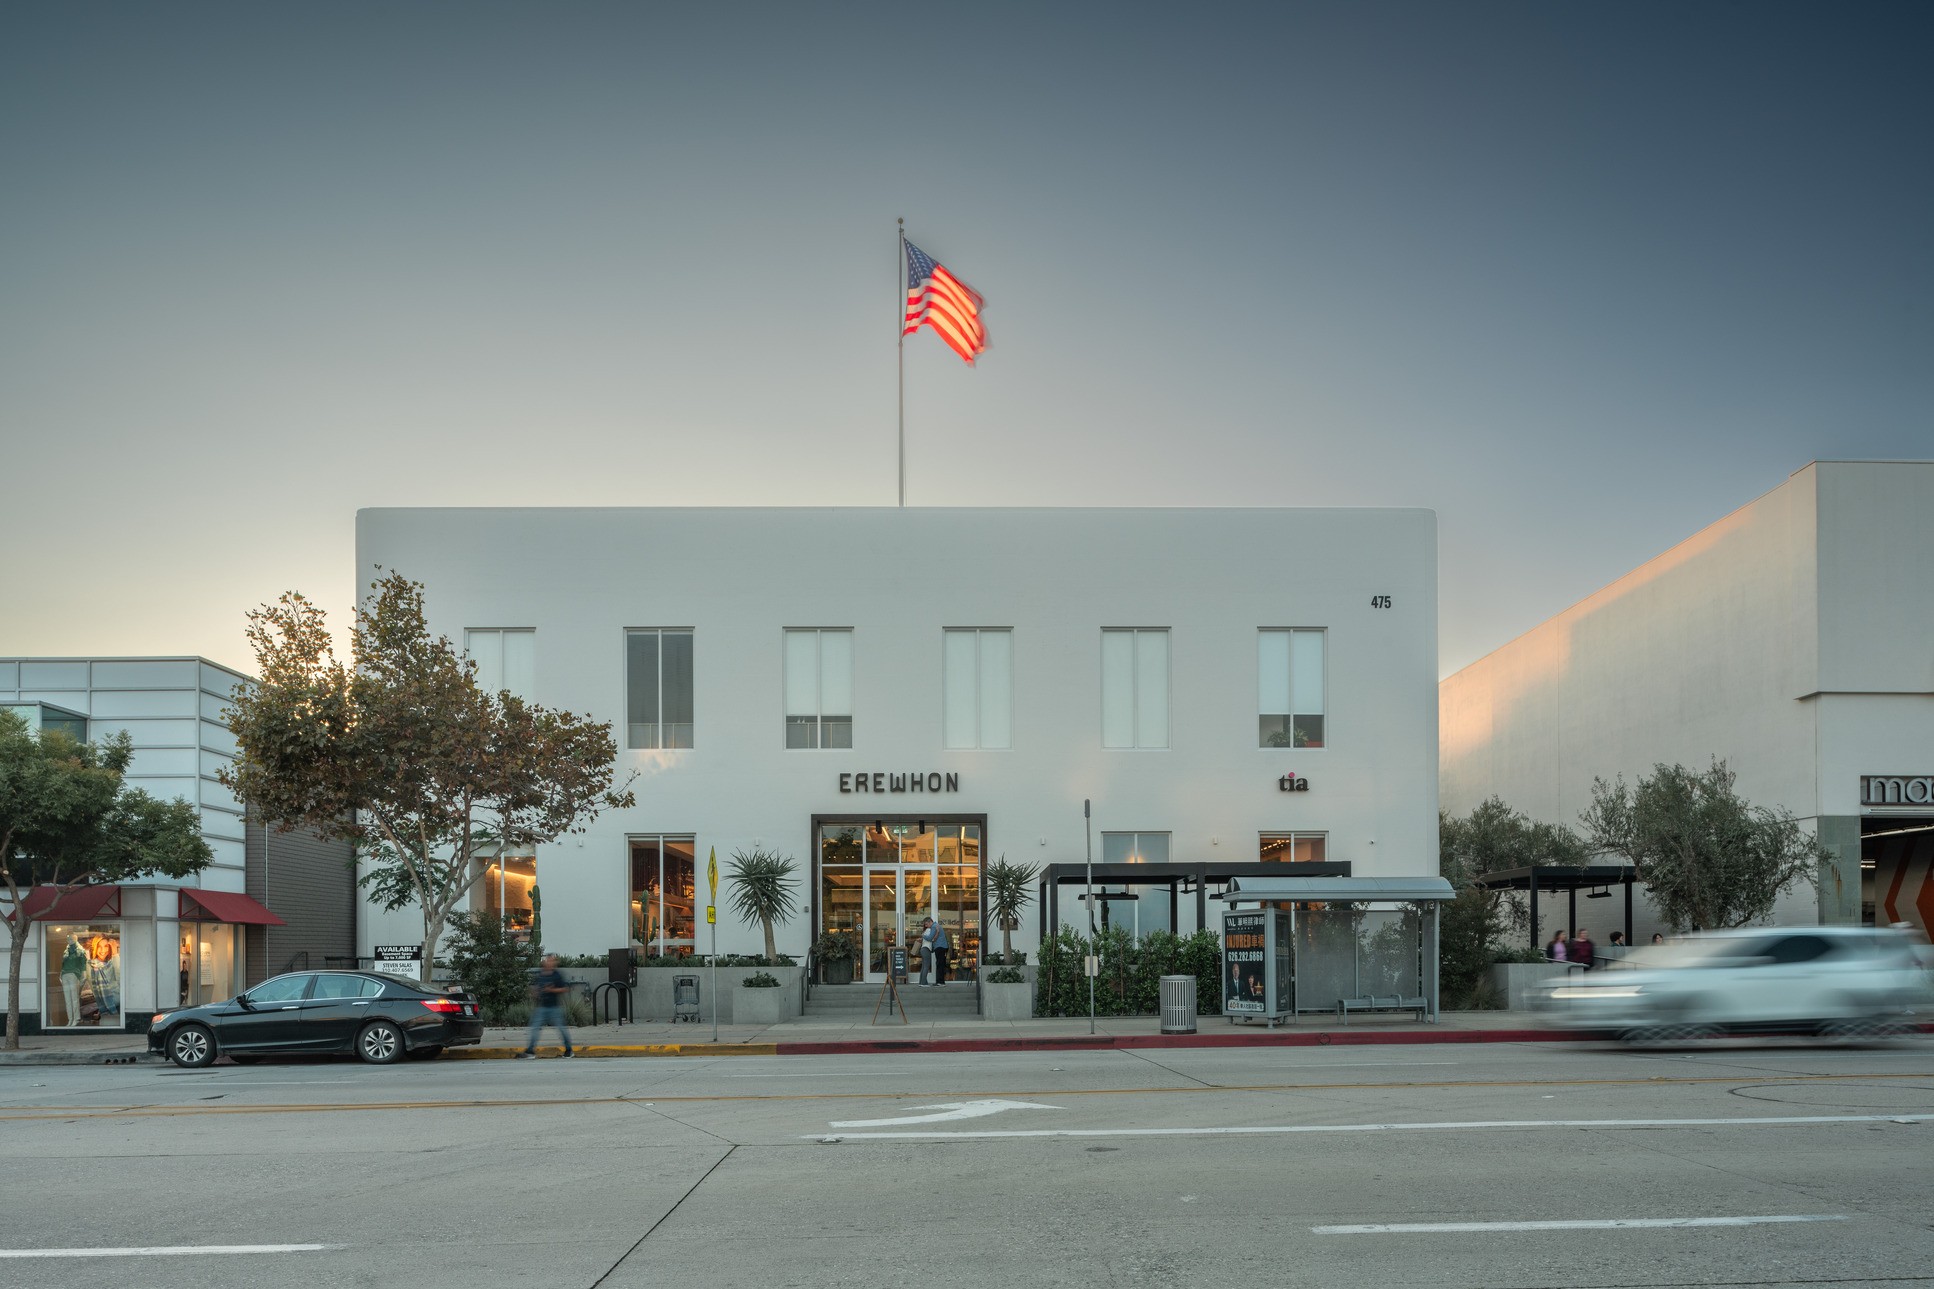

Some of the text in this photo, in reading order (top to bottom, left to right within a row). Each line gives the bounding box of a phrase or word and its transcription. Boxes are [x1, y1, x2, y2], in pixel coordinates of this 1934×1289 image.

[1371, 596, 1391, 608] 475
[840, 772, 958, 792] EREWHON
[1279, 772, 1310, 791] tia
[1868, 778, 1934, 802] ma
[1226, 934, 1251, 949] INJURED
